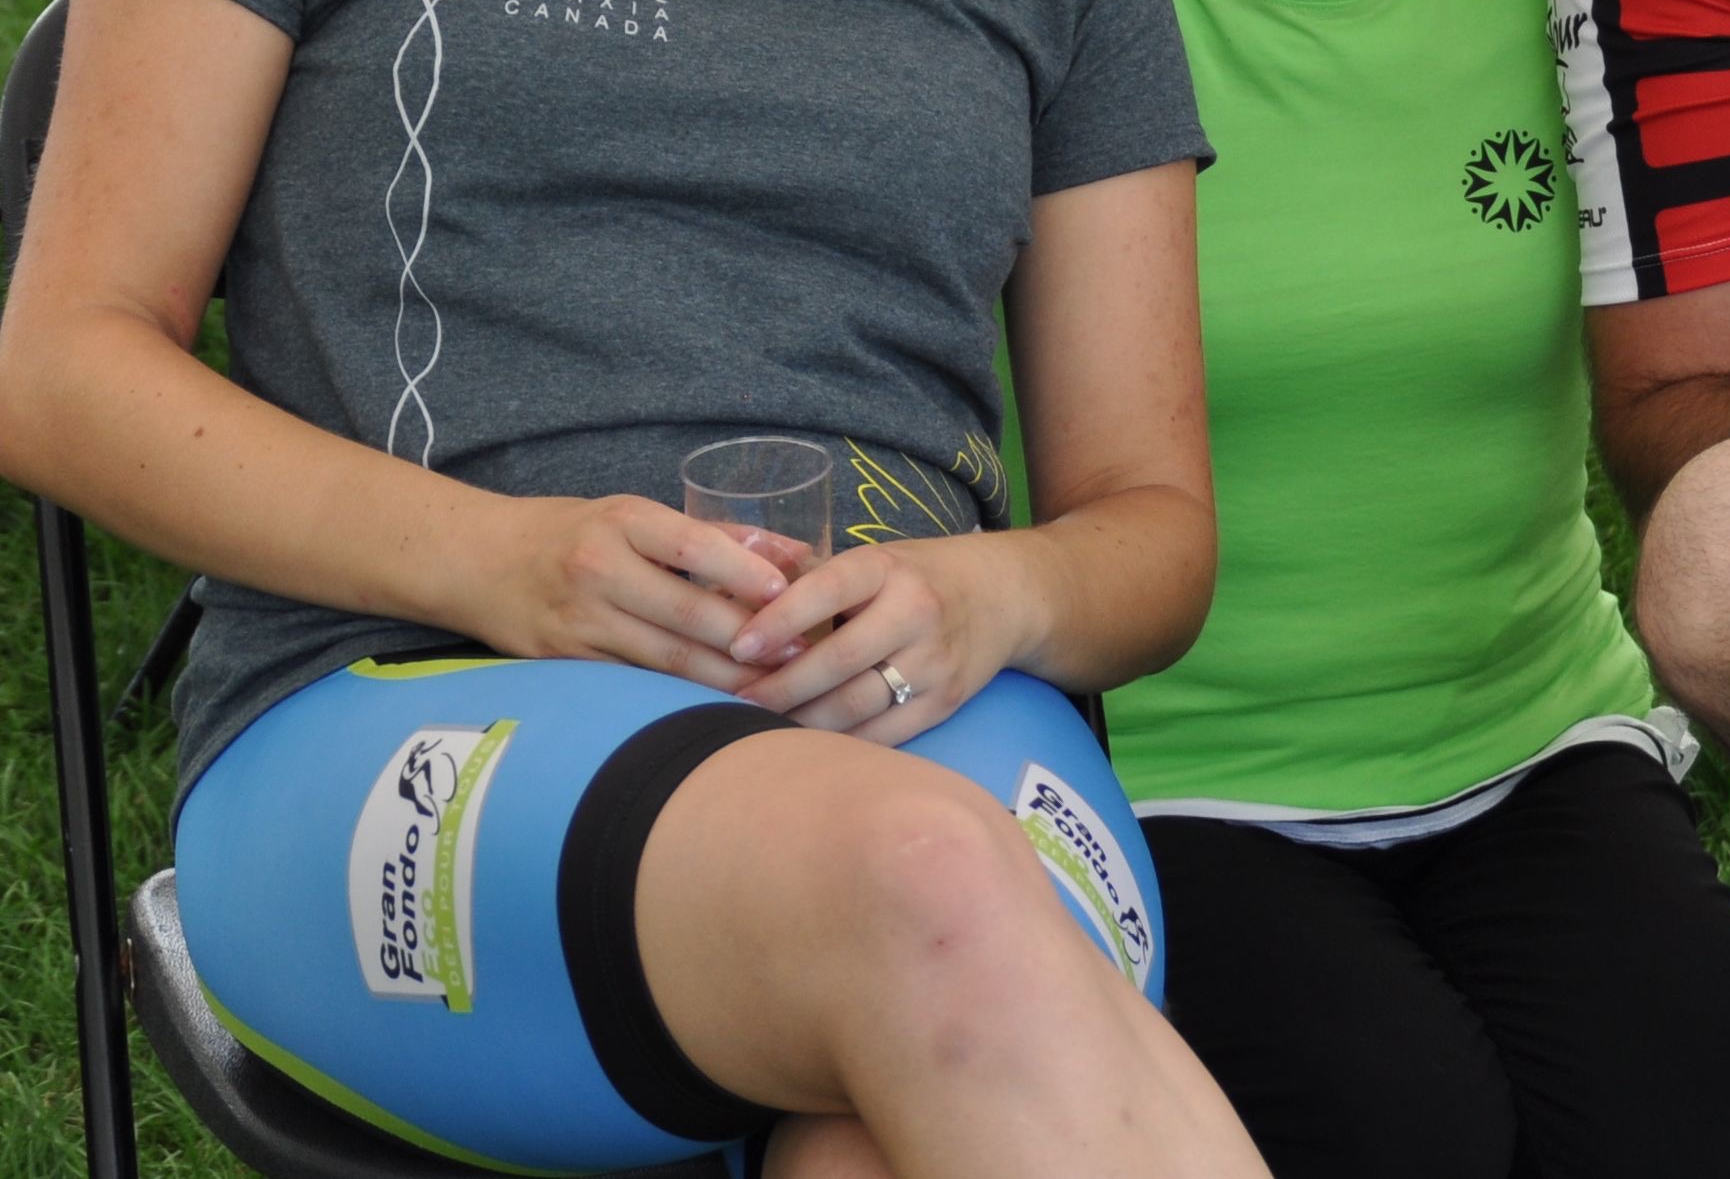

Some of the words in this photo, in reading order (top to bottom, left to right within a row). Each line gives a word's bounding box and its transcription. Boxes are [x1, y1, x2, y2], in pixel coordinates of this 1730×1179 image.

[1028, 796, 1120, 905] Fondo
[1036, 782, 1107, 863] Gran
[380, 862, 400, 980] Gran
[400, 824, 424, 984] Fondo
